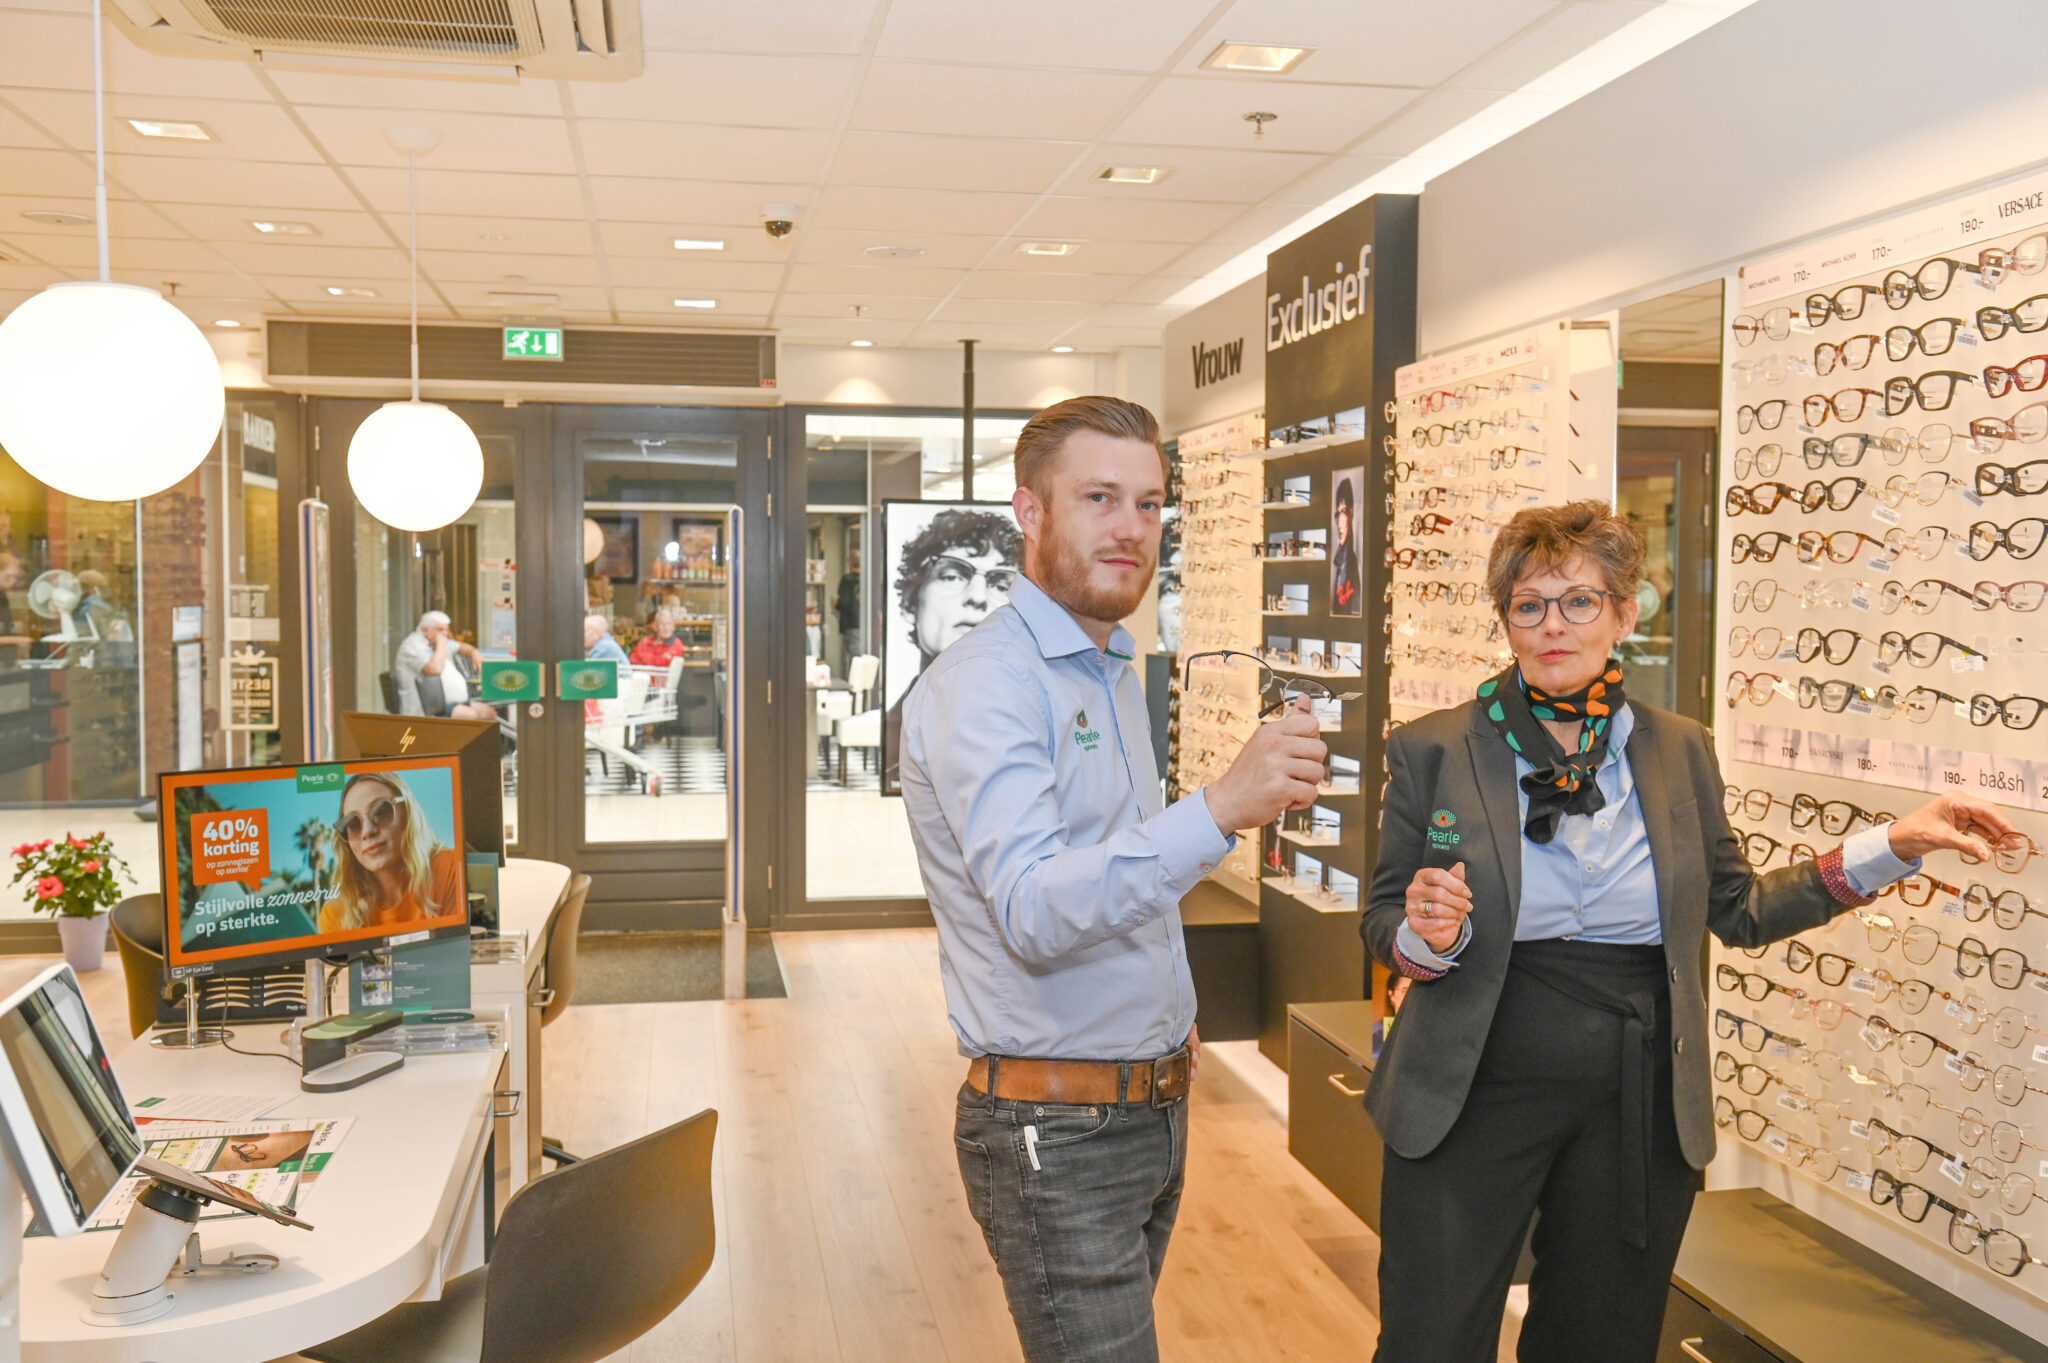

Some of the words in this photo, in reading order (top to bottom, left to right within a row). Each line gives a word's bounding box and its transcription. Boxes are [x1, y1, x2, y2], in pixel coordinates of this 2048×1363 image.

[1998, 191, 2044, 218] VERSACE
[1960, 218, 1984, 233] 190.-
[1872, 246, 1892, 260] 170.-
[1793, 270, 1811, 283] 170.-
[1267, 244, 1372, 352] Exclusief
[1192, 337, 1244, 389] Vrouw
[1074, 729, 1100, 745] Pearle
[1857, 758, 1878, 771] 180.-
[301, 774, 324, 782] Pearle
[1944, 771, 1967, 786] 190.-
[1979, 768, 2025, 793] ba&sh
[202, 817, 259, 842] 40%
[1427, 826, 1461, 844] Pearle
[203, 839, 260, 857] korting
[206, 861, 216, 869] op
[217, 856, 259, 868] zonneglazen
[216, 867, 225, 876] op
[194, 895, 265, 918] Stijlvolle
[266, 882, 341, 908] zonnebril
[195, 922, 216, 937] op
[219, 911, 279, 932] sterkte.
